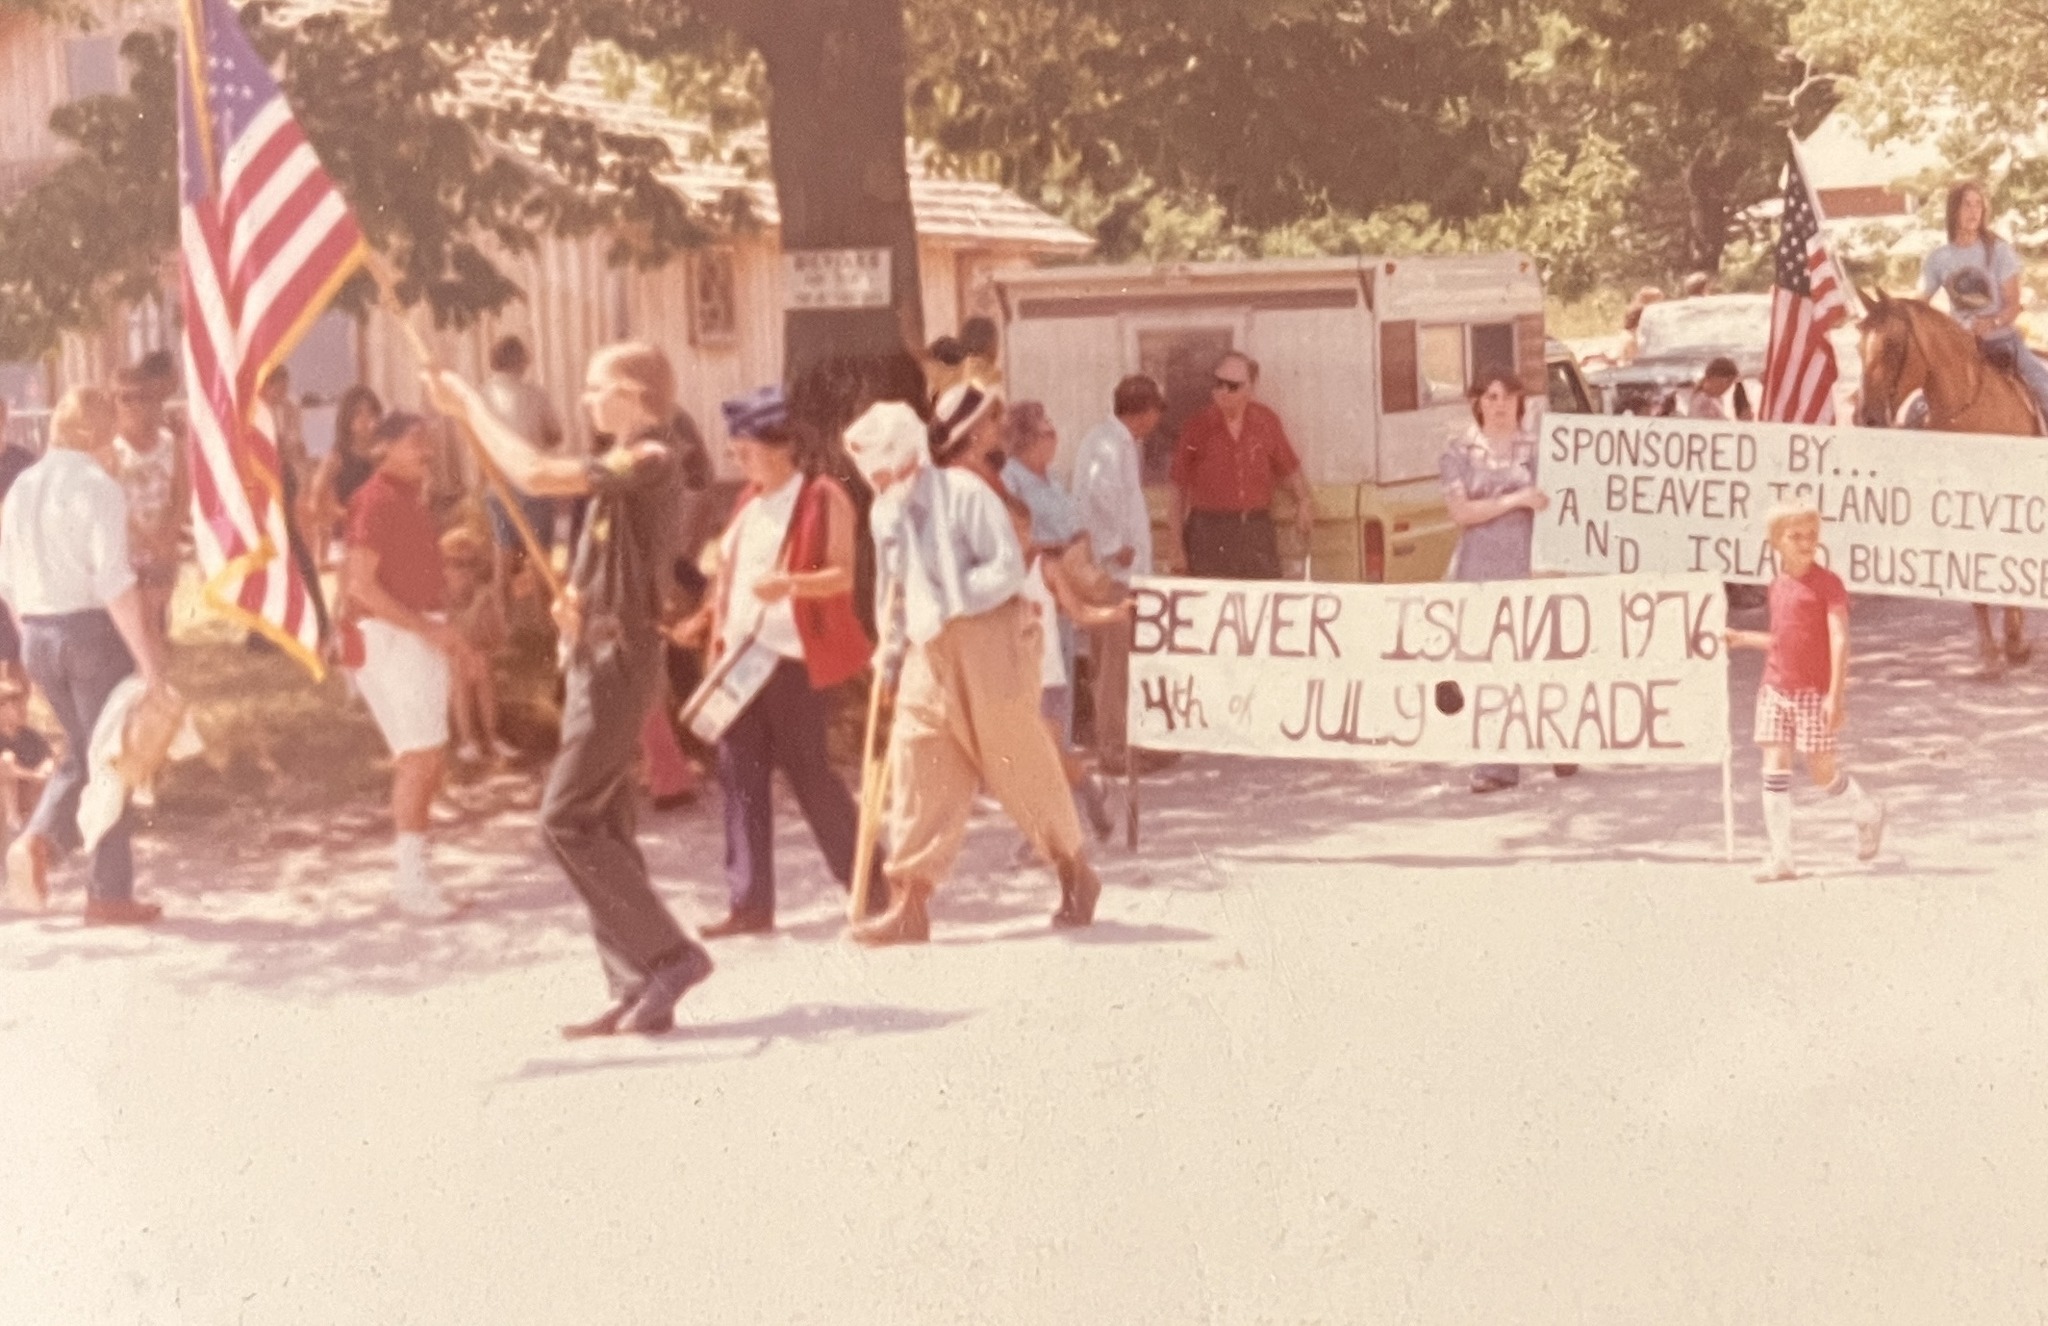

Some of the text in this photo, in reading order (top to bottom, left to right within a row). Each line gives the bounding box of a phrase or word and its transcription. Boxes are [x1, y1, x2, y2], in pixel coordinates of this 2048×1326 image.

[1551, 426, 1757, 472] SPONSORED
[1606, 474, 1750, 519] BEAVER
[1931, 489, 2046, 534] CIVIC
[1687, 535, 1830, 578] ISLAD
[1129, 588, 1719, 661] BEAVER ISLAND 1976
[1140, 674, 1209, 731] 4th
[1280, 679, 1426, 747] JULY
[1472, 679, 1686, 749] PARADE
